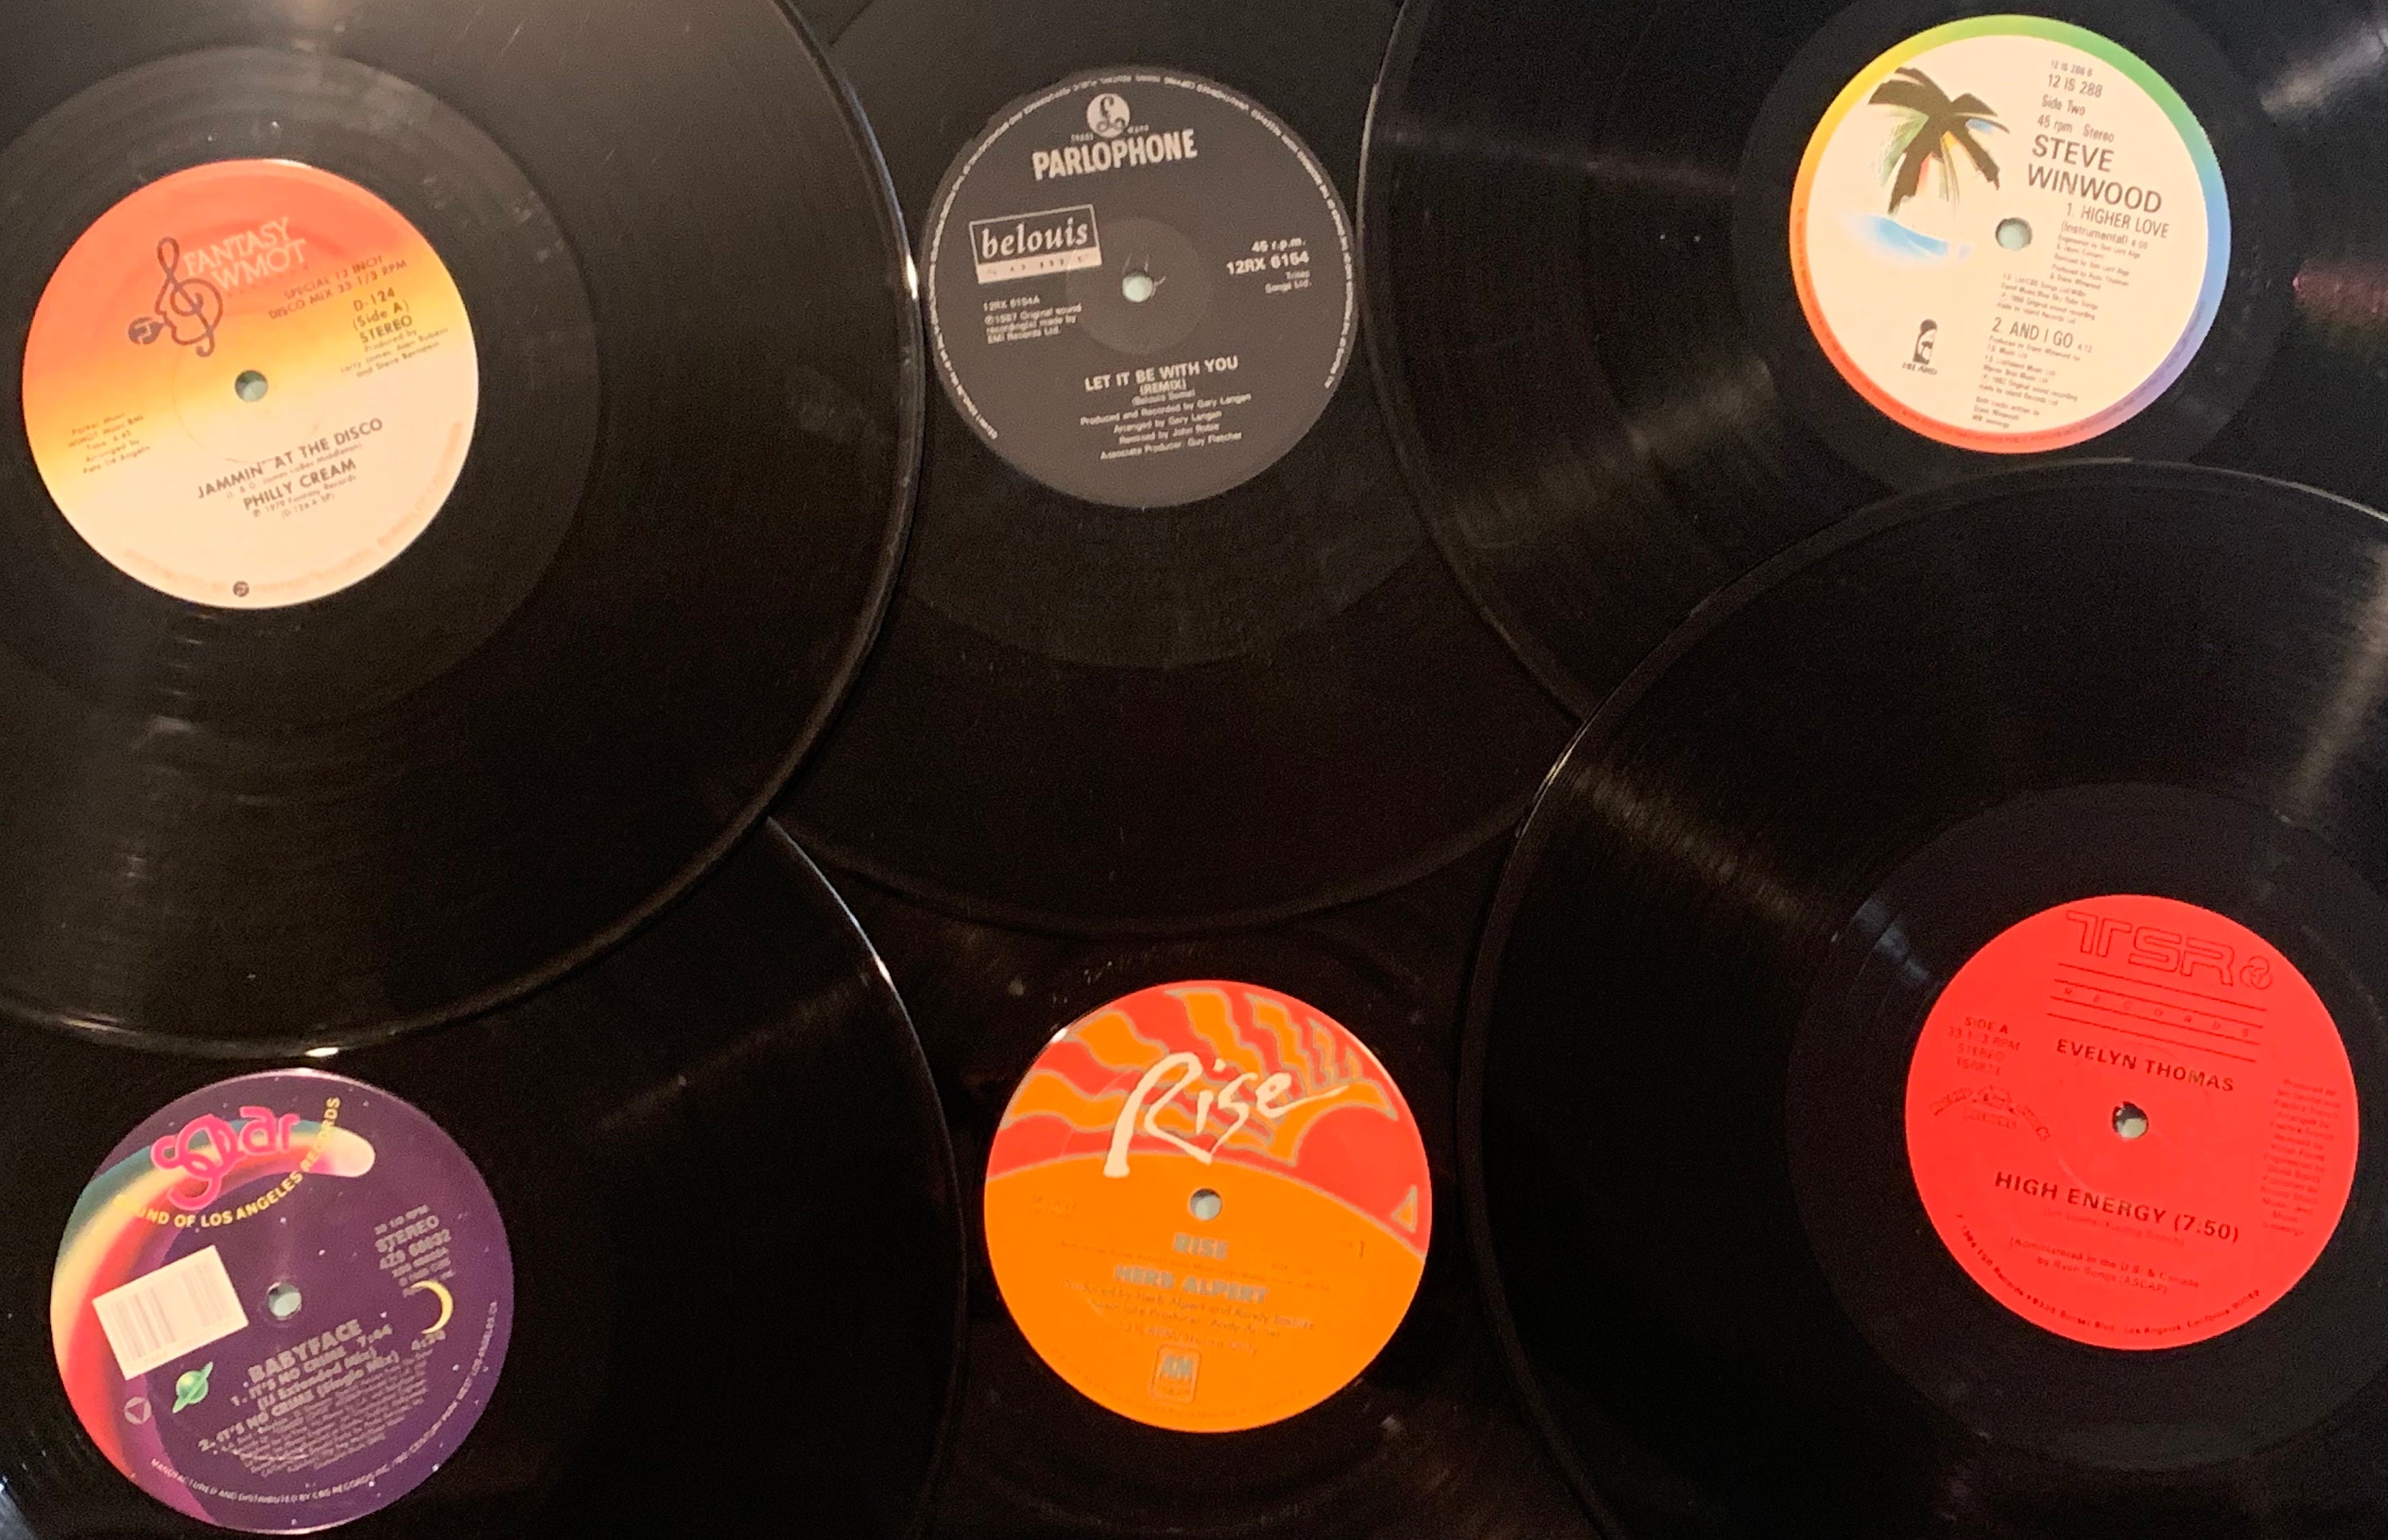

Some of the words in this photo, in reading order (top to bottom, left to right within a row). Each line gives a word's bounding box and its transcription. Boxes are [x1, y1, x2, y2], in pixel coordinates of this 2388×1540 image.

[2041, 94, 2062, 111] Side
[2066, 99, 2086, 117] Two
[2048, 73, 2062, 89] 12
[2064, 78, 2076, 92] IS
[2079, 80, 2103, 98] 288
[2037, 114, 2050, 129] 45
[2054, 120, 2073, 134] rpm
[2082, 123, 2115, 143] Stereo
[1032, 129, 1198, 181] PARLOPHONE
[2031, 134, 2115, 173] STEVE
[2028, 163, 2163, 213] WINWOOD
[981, 216, 1088, 259] belouis
[2060, 220, 2129, 245] (Instrumental)
[2080, 205, 2132, 230] HIGHER
[2135, 216, 2170, 239] LOVE
[183, 216, 289, 278] FANTASY
[210, 237, 306, 291] WMOT
[1226, 256, 1266, 275] 12RX
[267, 299, 306, 320] DISCO
[309, 288, 333, 305] MIX
[382, 259, 408, 276] RPM
[283, 276, 330, 300] SPECIAL
[352, 255, 383, 274] INCH
[352, 309, 388, 331] (Side
[393, 299, 410, 314] A)
[353, 287, 396, 313] D-124
[359, 315, 413, 344] STEREO
[2009, 321, 2039, 341] AND
[2043, 328, 2050, 343] I
[2053, 330, 2074, 349] GO
[1084, 374, 1112, 392] LET
[1116, 371, 1130, 387] IT
[1135, 367, 1156, 384] BE
[1159, 361, 1200, 380] WITH
[1204, 355, 1239, 373] YOU
[1122, 409, 1139, 420] and
[1182, 400, 1195, 412] by
[275, 451, 294, 470] AT
[298, 438, 330, 458] THE
[333, 418, 383, 446] DISCO
[243, 481, 294, 510] PHILLY
[298, 458, 357, 488] CREAM
[2066, 910, 2235, 987] TSR
[1964, 1016, 1996, 1031] SIDE
[1999, 1024, 2008, 1035] A
[2063, 987, 2250, 1038] RECORDS
[1957, 1043, 2006, 1063] STEREO
[2056, 1038, 2138, 1070] EVELYN
[2144, 1059, 2235, 1093] THOMAS
[1102, 1051, 1349, 1179] Rise
[173, 1214, 197, 1228] OF
[201, 1209, 233, 1229] LOS
[236, 1169, 304, 1222] ANGELES
[1994, 1171, 2058, 1201] HIGH
[2066, 1187, 2168, 1224] ENERGY
[375, 1215, 439, 1253] STEREO
[1174, 1232, 1229, 1261] RISE
[1114, 1262, 1176, 1289] HERB
[1181, 1274, 1270, 1304] ALPERT
[2147, 1268, 2156, 1279] &
[248, 1318, 362, 1384] BABYFACE
[248, 1378, 277, 1399] IT'S
[278, 1367, 302, 1385] NO
[302, 1346, 347, 1374] CRIME
[277, 1361, 343, 1401] Extended
[343, 1345, 378, 1370] Mix)
[215, 1421, 246, 1442] IT'S
[246, 1411, 270, 1430] NO
[271, 1389, 315, 1417] CRIME
[316, 1368, 366, 1398] (Single
[365, 1350, 400, 1373] Mix)
